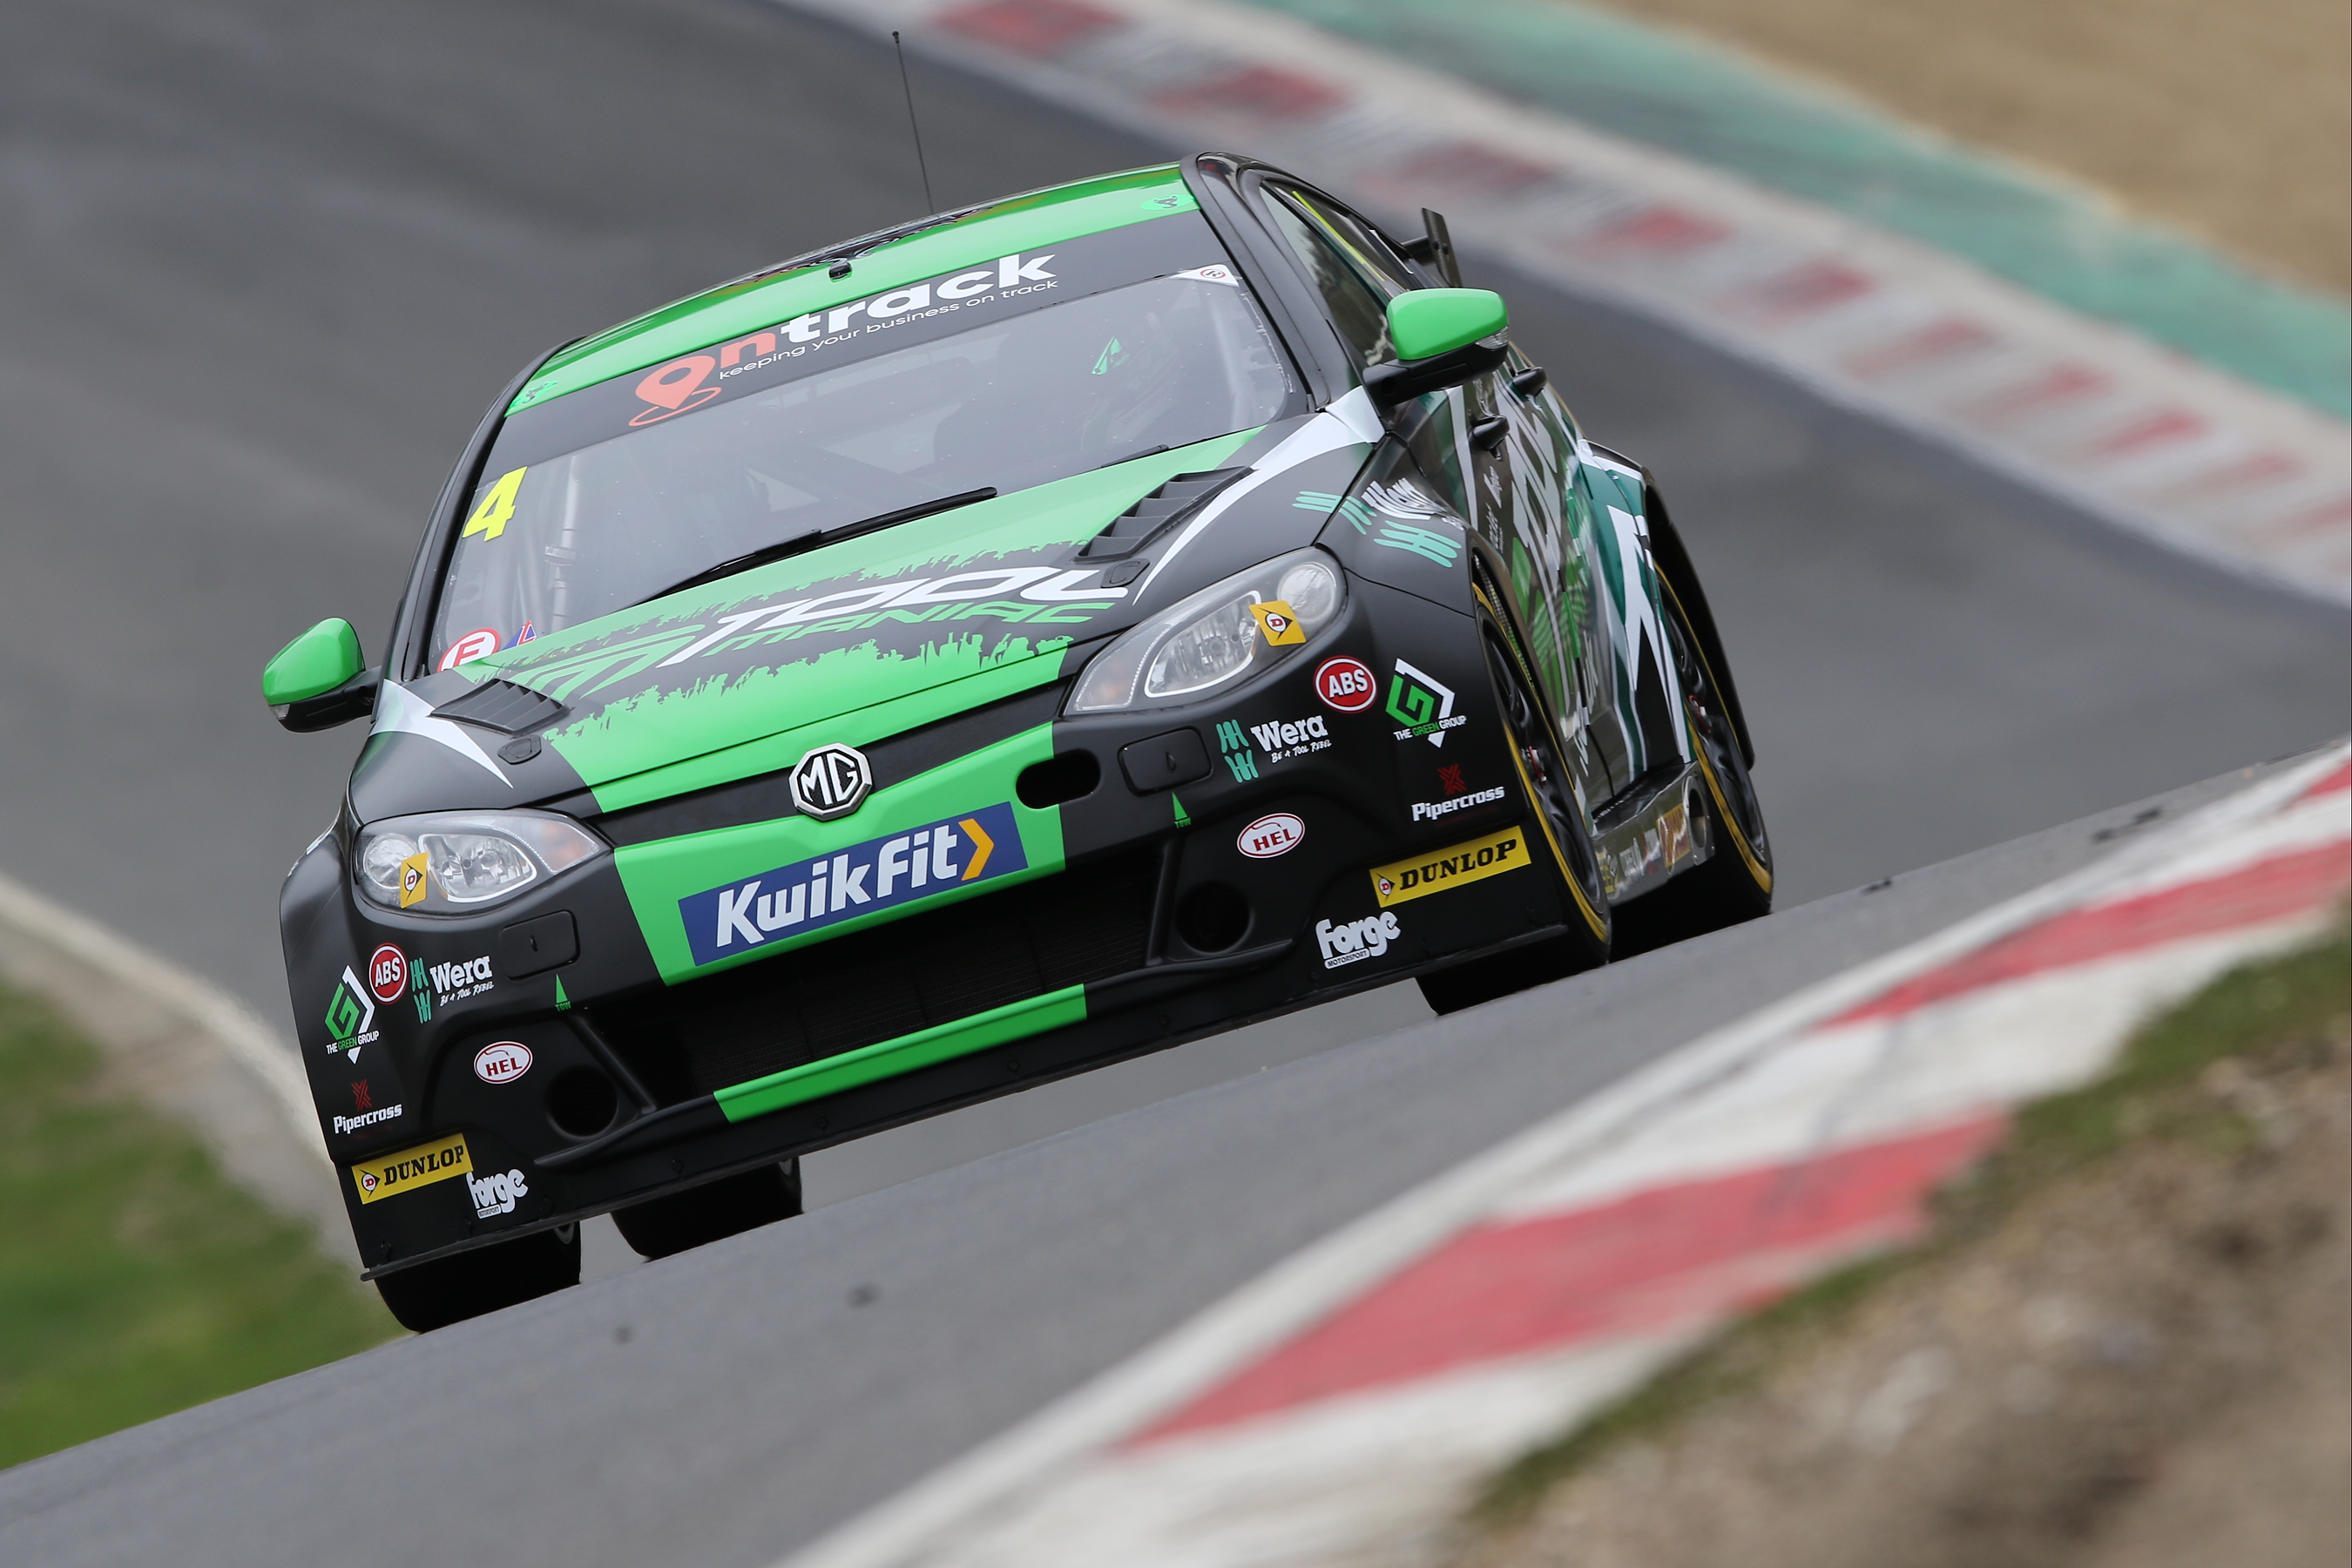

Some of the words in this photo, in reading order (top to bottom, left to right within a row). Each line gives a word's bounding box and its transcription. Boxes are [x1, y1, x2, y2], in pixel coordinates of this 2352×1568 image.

[720, 347, 806, 381] keeping
[812, 328, 861, 352] your
[866, 303, 960, 335] business
[965, 294, 995, 308] on
[1000, 280, 1058, 299] track
[462, 466, 528, 542] 4
[654, 566, 1129, 670] TOOL
[1328, 668, 1369, 699] ABS
[1250, 715, 1329, 752] Wera
[1393, 727, 1413, 740] THE
[1412, 722, 1441, 737] GREEN
[1438, 714, 1468, 729] GROUP
[800, 752, 859, 807] MG
[1411, 786, 1505, 821] Pipercross
[1174, 817, 1191, 828] TOW
[1253, 828, 1296, 852] HEL
[1399, 838, 1517, 890] DUNLOP
[375, 956, 402, 988] ABS
[429, 955, 493, 995] Wera
[1327, 950, 1368, 968] MOTORSPORT
[555, 1001, 571, 1011] TOW
[326, 1042, 338, 1055] THE
[337, 1037, 357, 1051] GREEN
[357, 1030, 380, 1045] GROUP
[484, 1057, 523, 1078] HEL
[333, 1104, 403, 1135] Pipercross
[382, 1144, 465, 1186] DUNLOP
